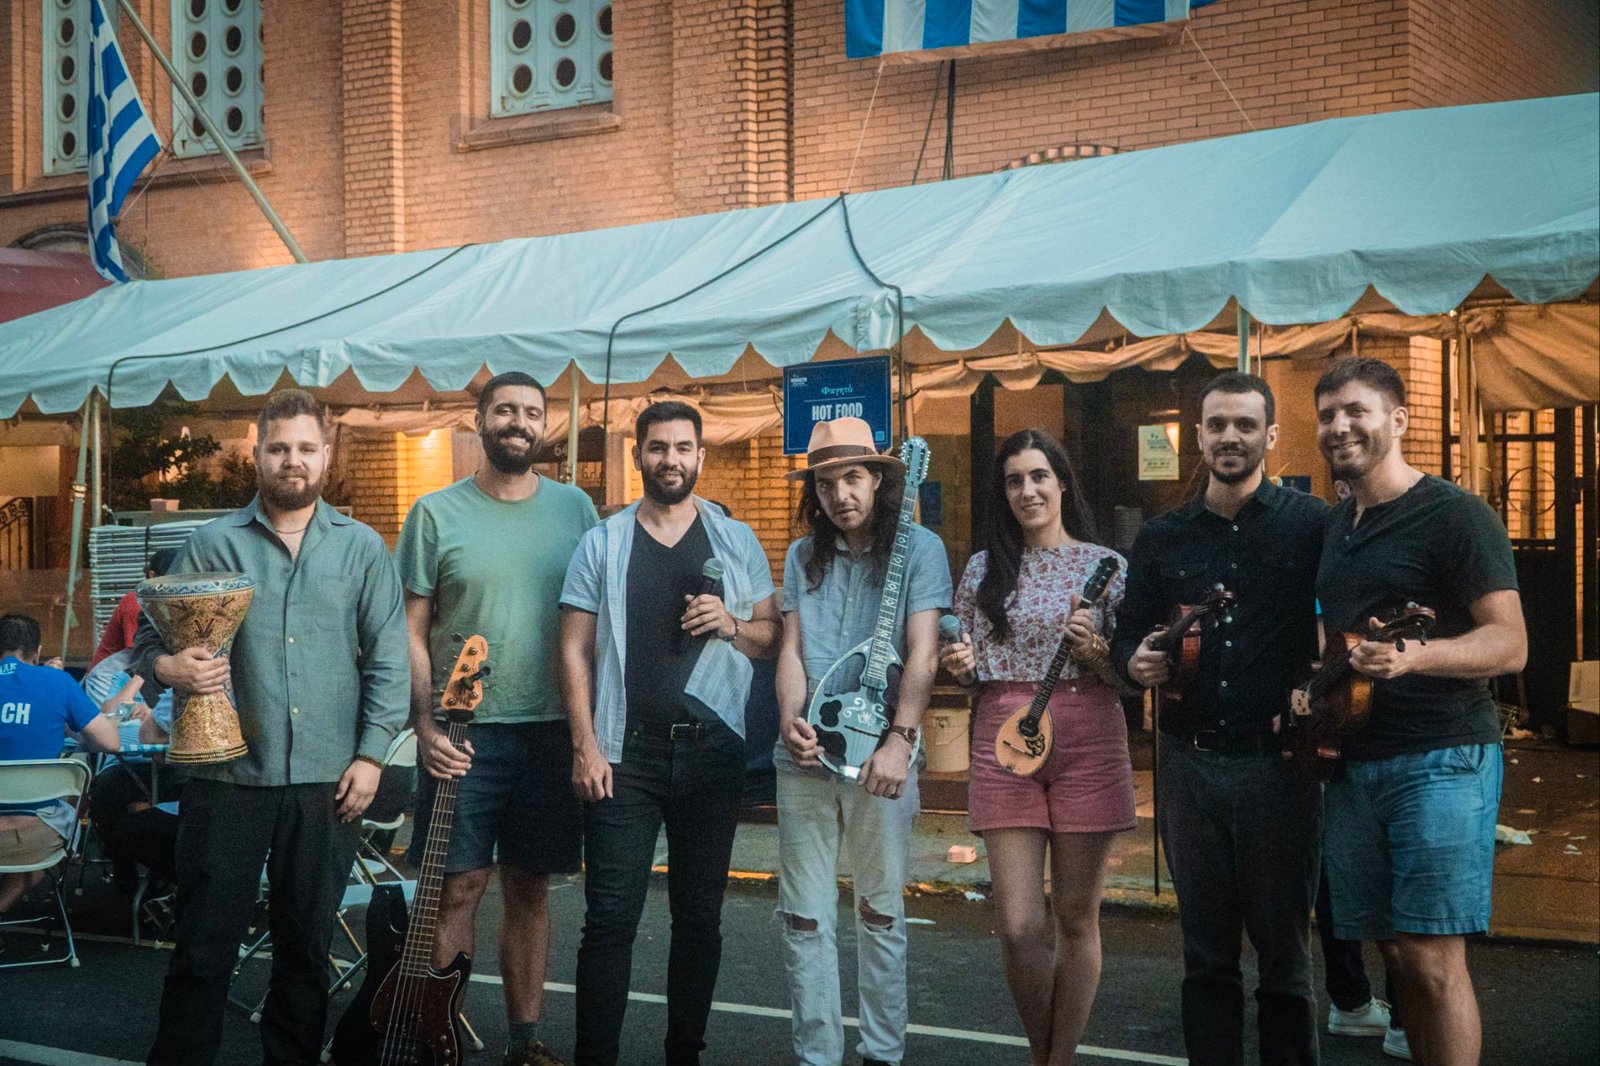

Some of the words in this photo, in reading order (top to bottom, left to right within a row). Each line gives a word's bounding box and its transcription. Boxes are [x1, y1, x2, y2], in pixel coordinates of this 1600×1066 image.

[821, 384, 853, 396] Φαγητό
[811, 404, 832, 421] HOT
[835, 402, 863, 419] FOOD
